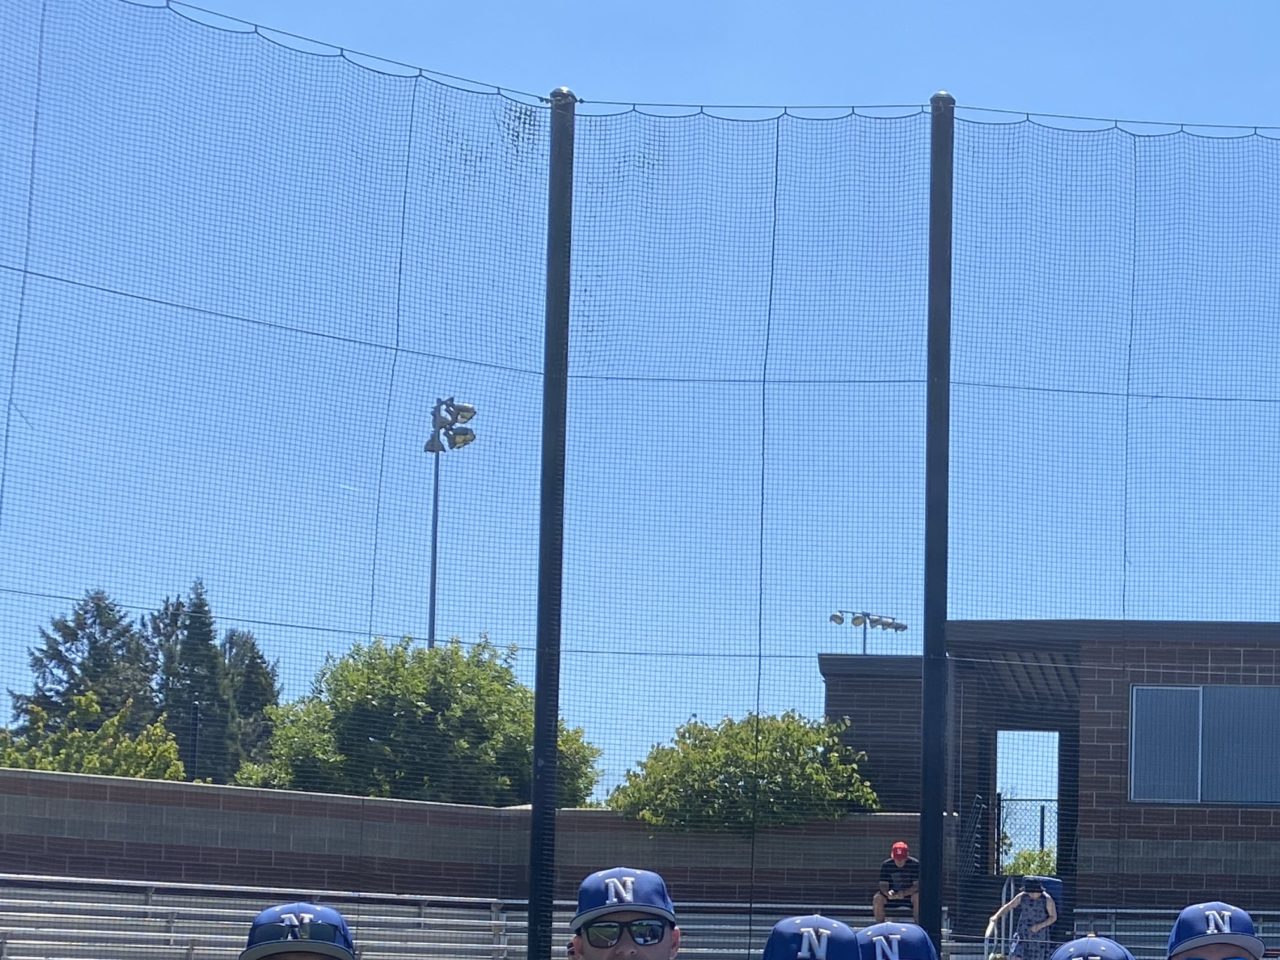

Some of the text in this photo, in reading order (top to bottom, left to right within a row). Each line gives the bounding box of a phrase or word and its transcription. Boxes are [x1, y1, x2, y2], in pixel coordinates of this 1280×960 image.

[605, 876, 635, 905] N
[1205, 910, 1233, 934] N
[797, 927, 831, 960] N
